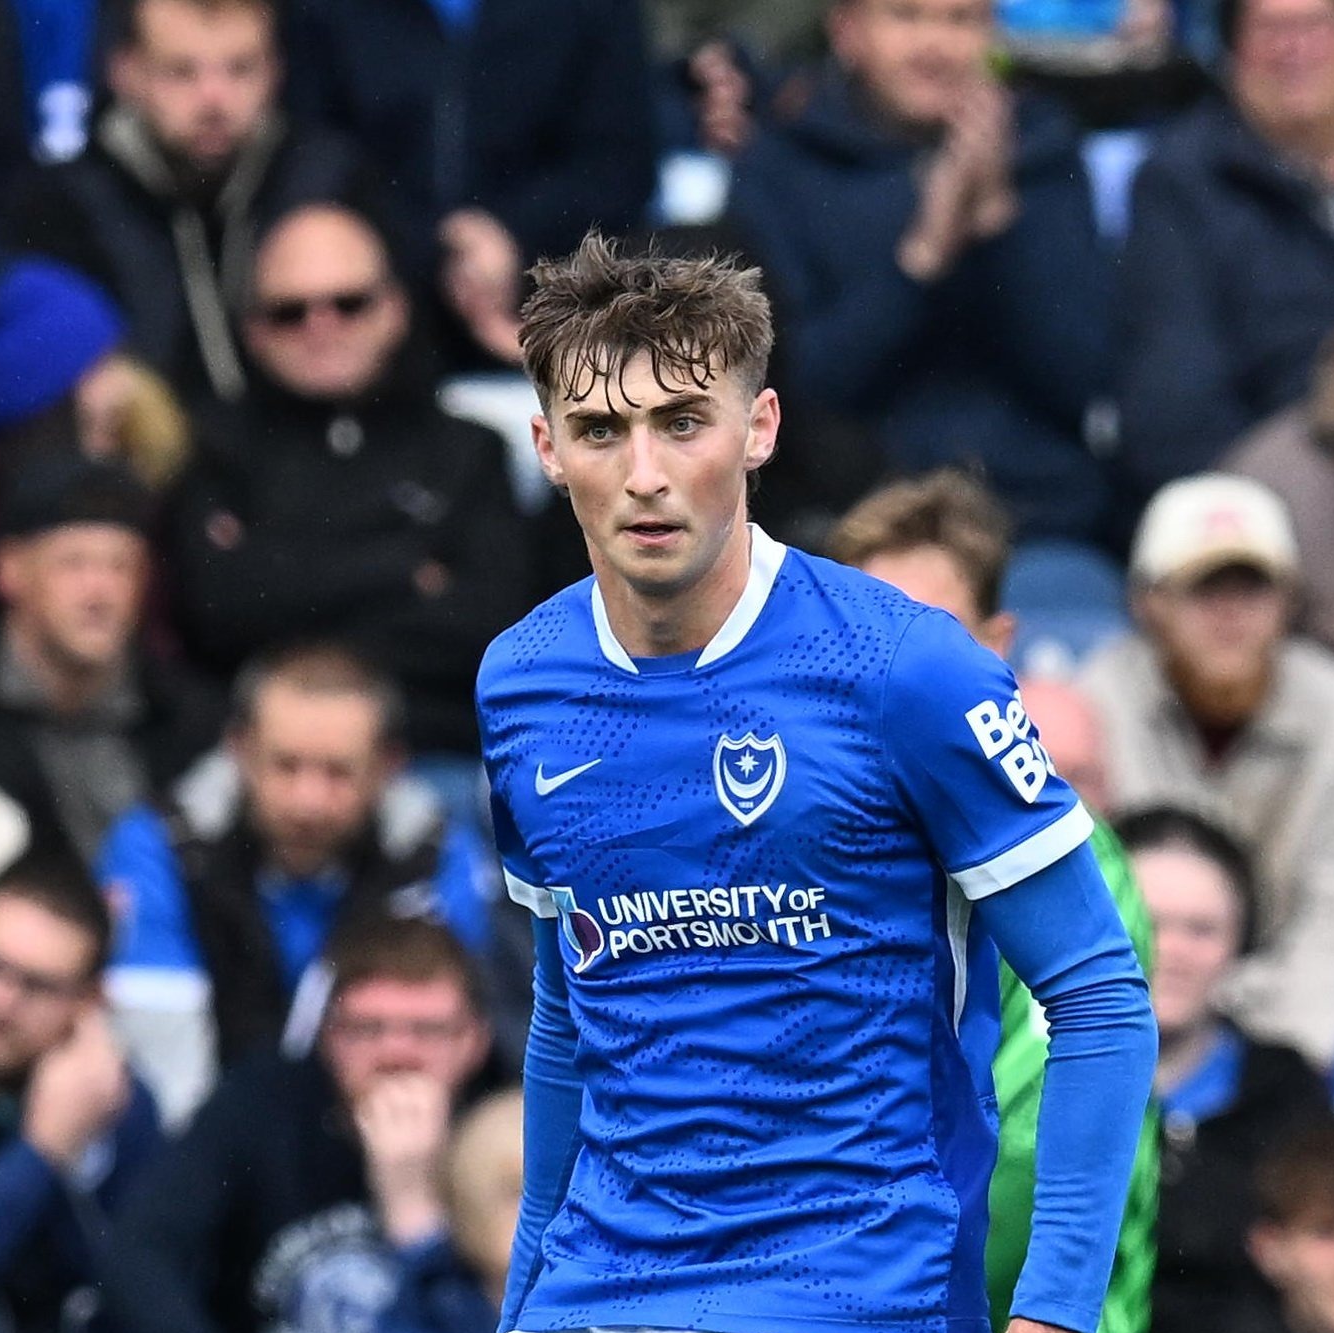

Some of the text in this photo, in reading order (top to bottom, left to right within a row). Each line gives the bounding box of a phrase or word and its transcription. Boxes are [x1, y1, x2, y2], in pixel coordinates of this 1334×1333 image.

[597, 883, 826, 926] UNIVERSITY OF
[609, 913, 832, 959] PORTSMOUTH
